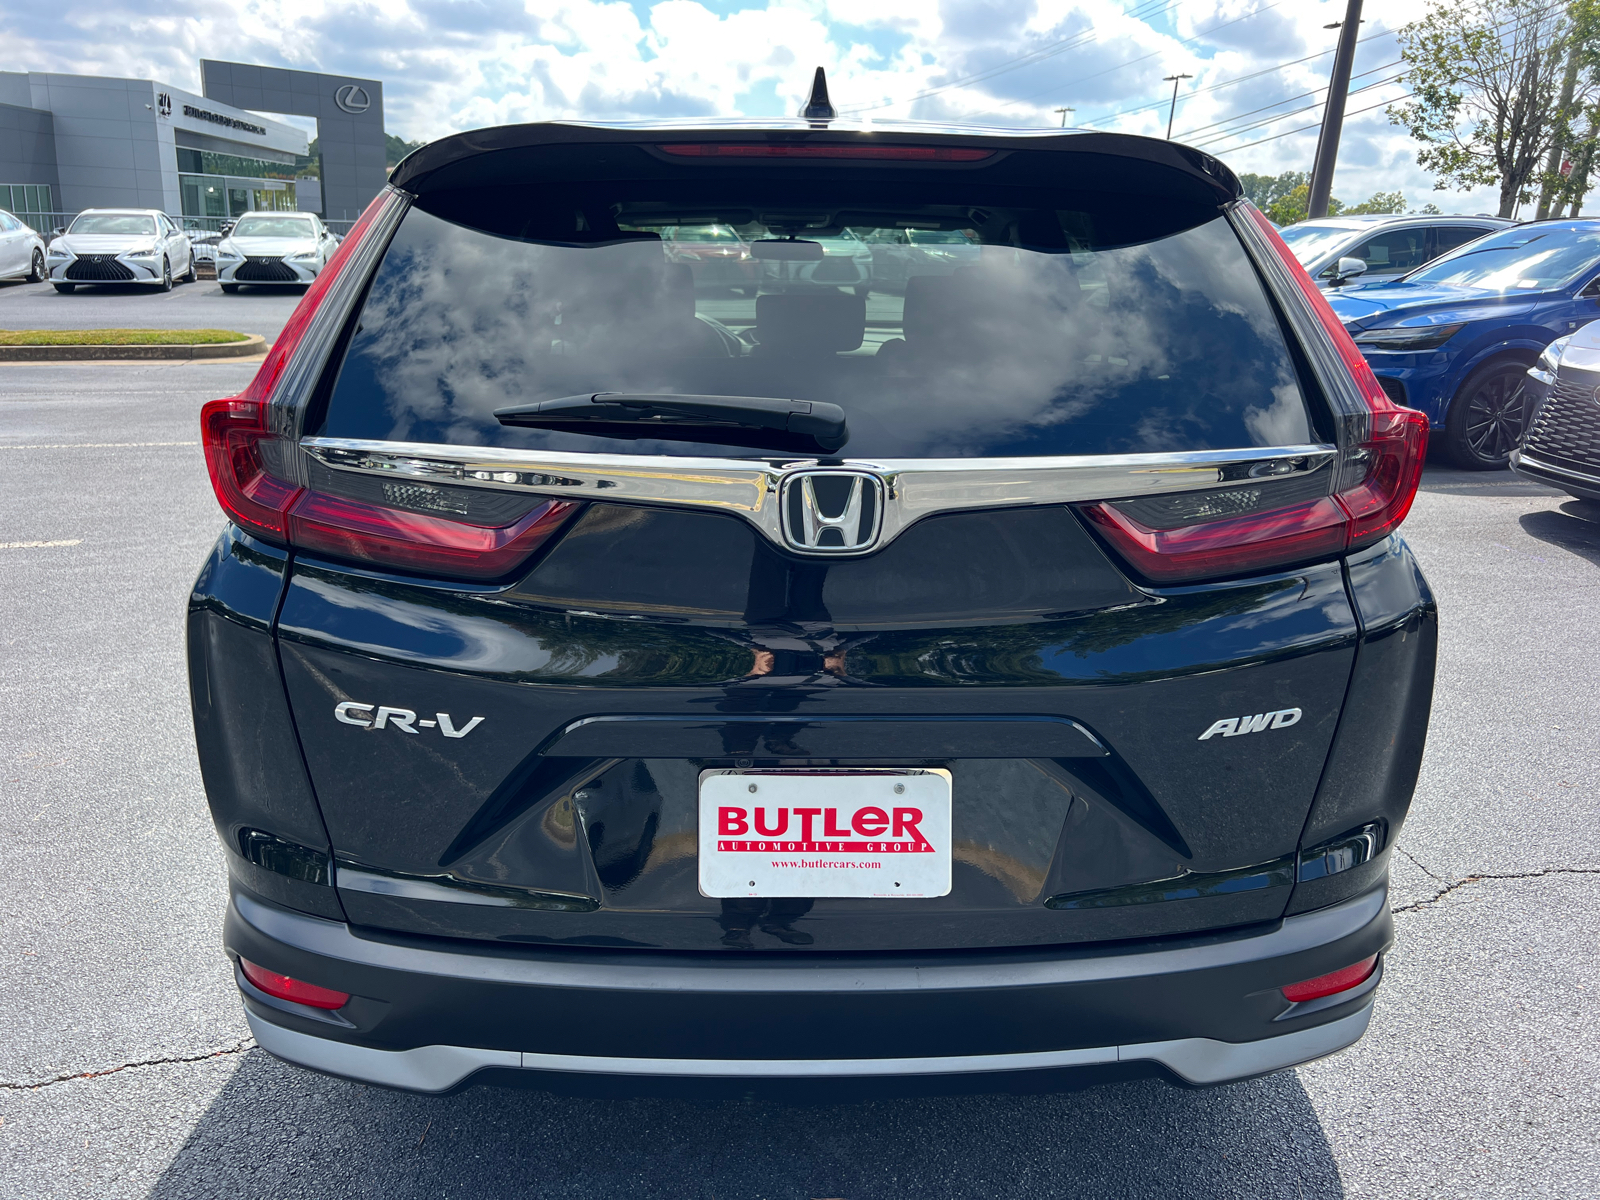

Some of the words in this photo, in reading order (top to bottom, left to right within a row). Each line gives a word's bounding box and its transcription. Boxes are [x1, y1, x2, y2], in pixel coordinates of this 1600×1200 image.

[334, 701, 485, 739] CR-V
[1197, 707, 1303, 741] AWD
[718, 841, 845, 852] AUTOMOTIVE
[866, 842, 928, 852] GROUP
[771, 859, 882, 869] www.butlercars.com
